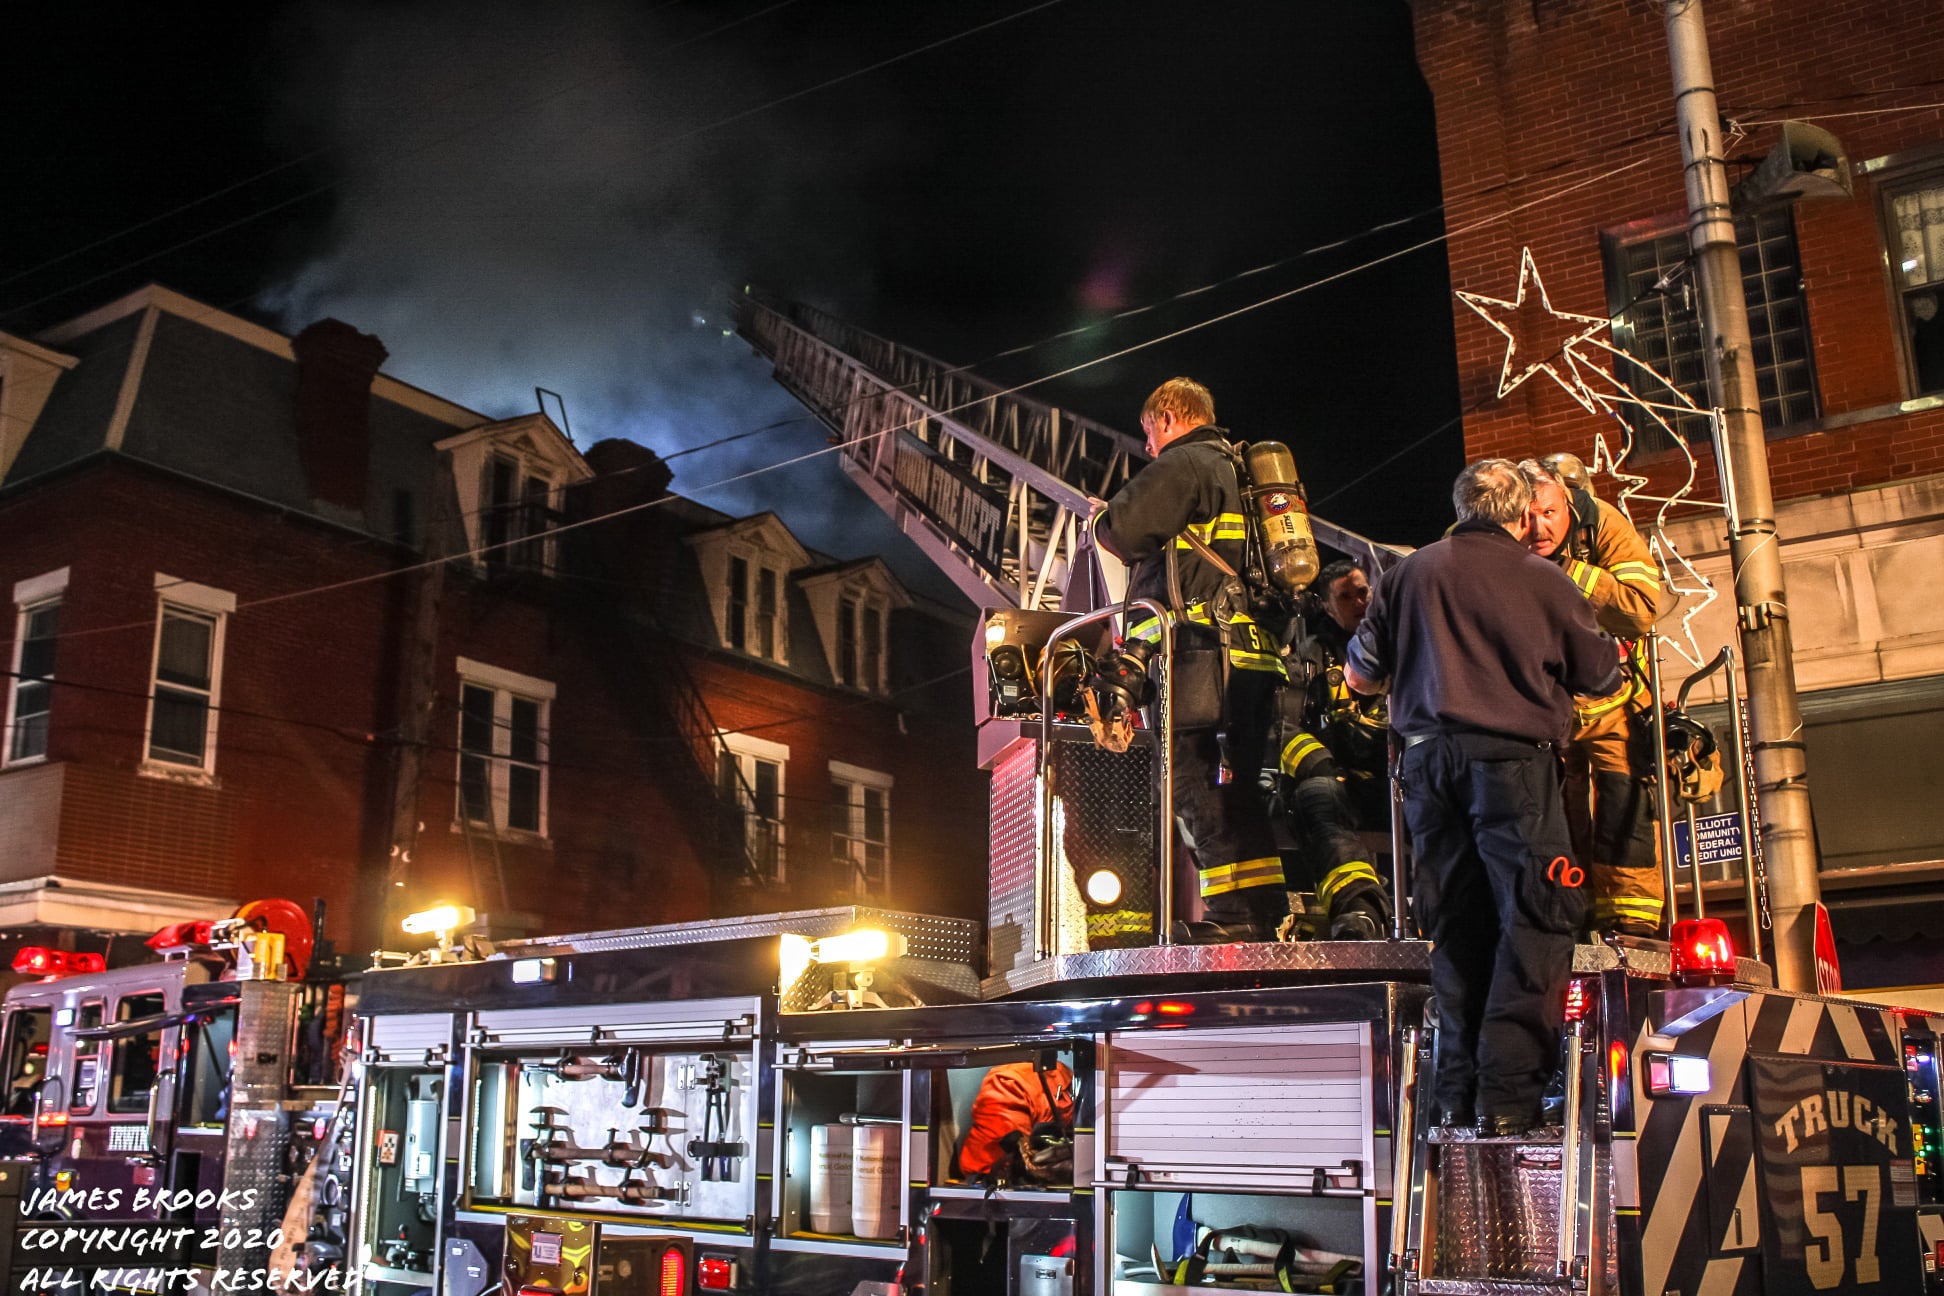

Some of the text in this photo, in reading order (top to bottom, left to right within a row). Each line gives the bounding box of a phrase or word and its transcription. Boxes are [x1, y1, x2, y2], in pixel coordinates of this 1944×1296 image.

[929, 464, 961, 533] FIRE
[1684, 847, 1742, 863] CEDIT UNIO
[1697, 838, 1737, 850] EDERAL
[1775, 1090, 1898, 1156] TRUCK
[1801, 1165, 1881, 1290] 57
